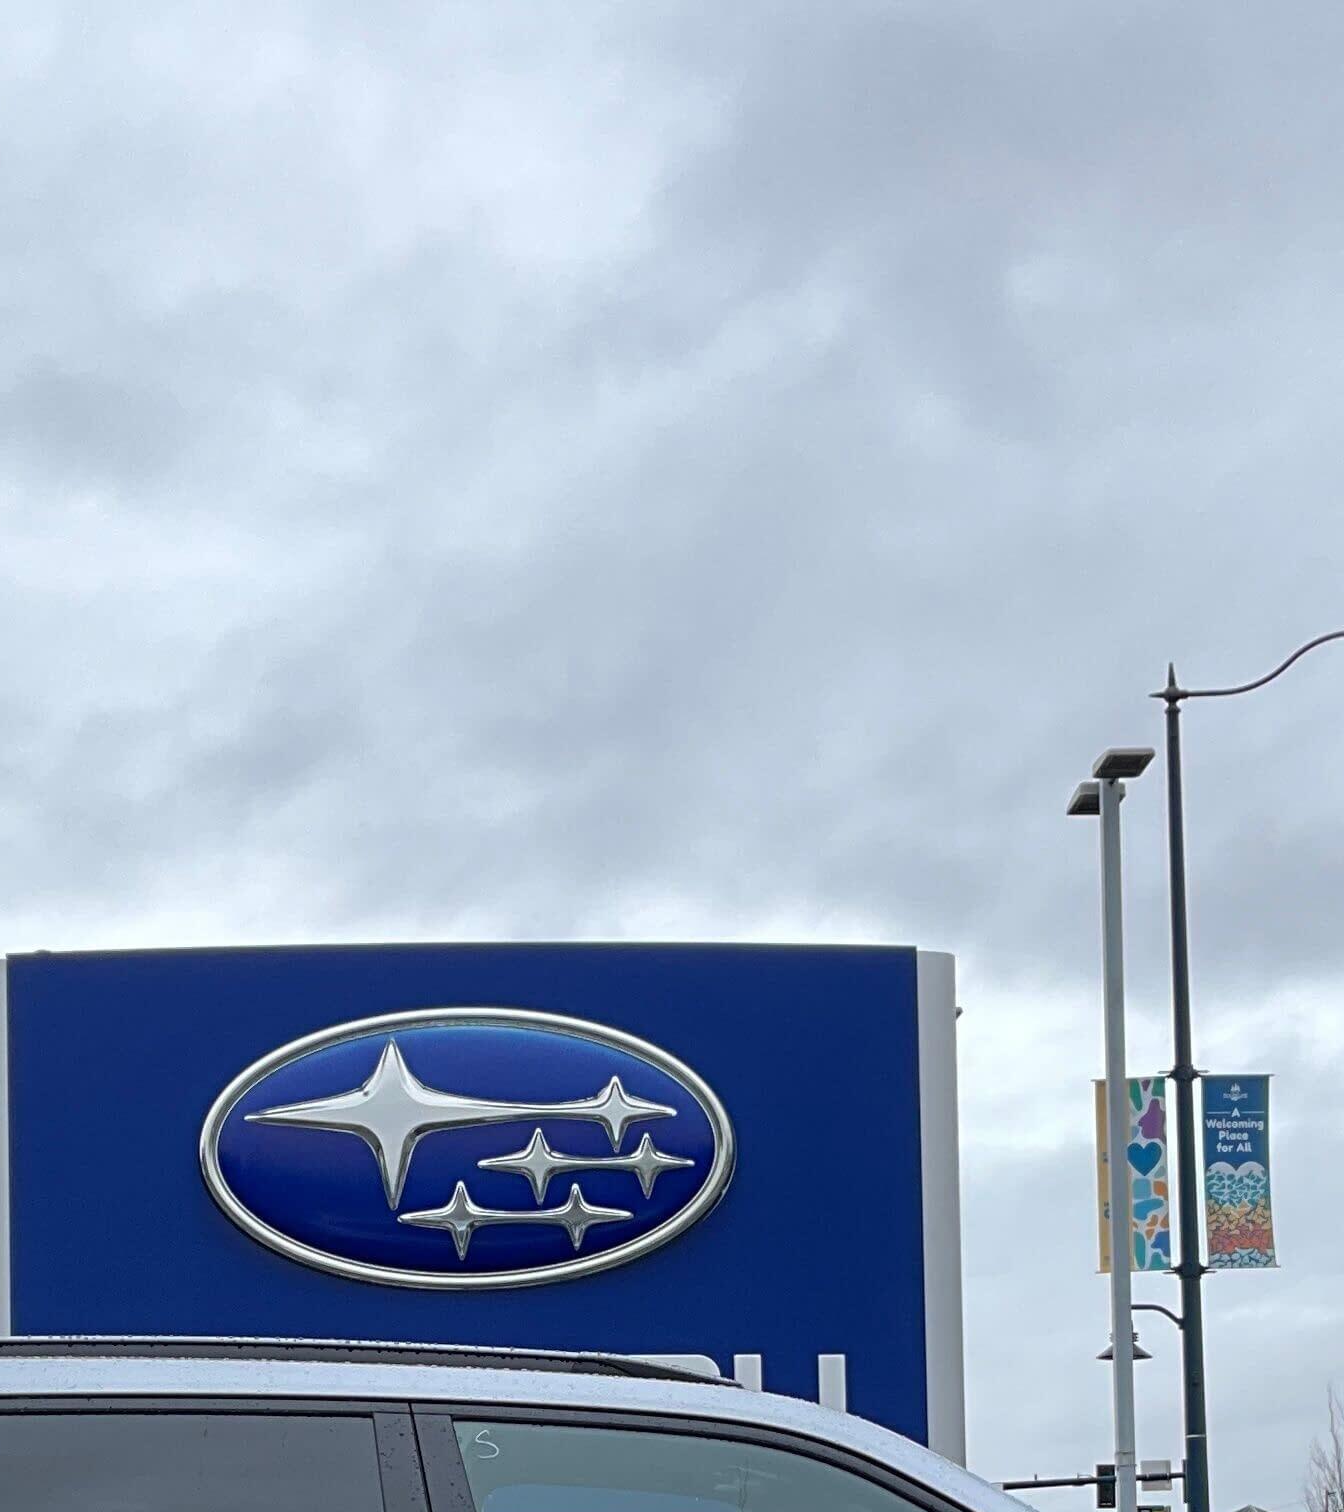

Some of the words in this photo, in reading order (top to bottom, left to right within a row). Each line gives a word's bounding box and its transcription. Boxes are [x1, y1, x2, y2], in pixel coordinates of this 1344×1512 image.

[1231, 1107, 1240, 1117] A
[1205, 1118, 1264, 1130] Welcoming
[1218, 1130, 1249, 1140] Place
[1216, 1142, 1233, 1152] for
[1236, 1142, 1252, 1152] All
